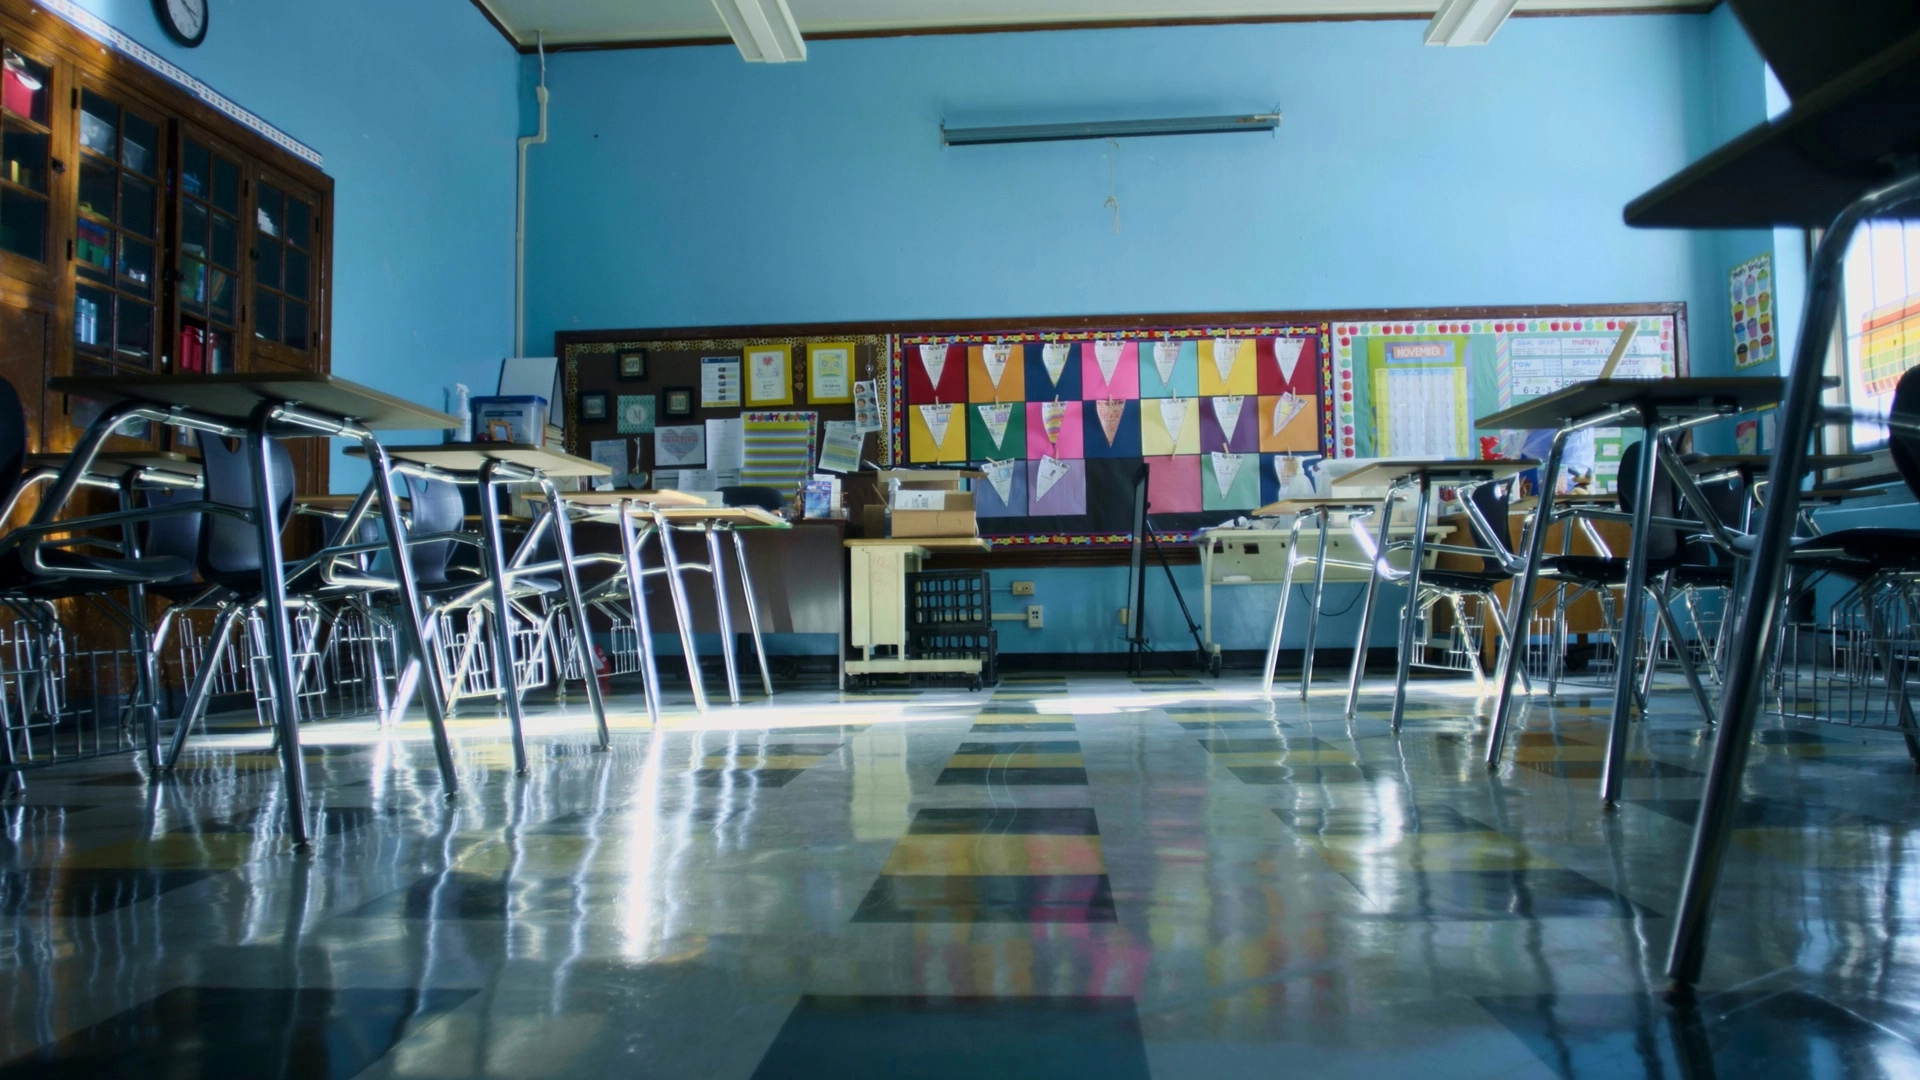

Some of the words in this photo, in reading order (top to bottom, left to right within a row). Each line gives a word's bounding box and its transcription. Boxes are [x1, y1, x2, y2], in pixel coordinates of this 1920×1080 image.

[1572, 338, 1600, 347] multiply
[1397, 346, 1442, 357] NOVEMBER
[1573, 359, 1600, 367] product
[632, 408, 641, 421] M
